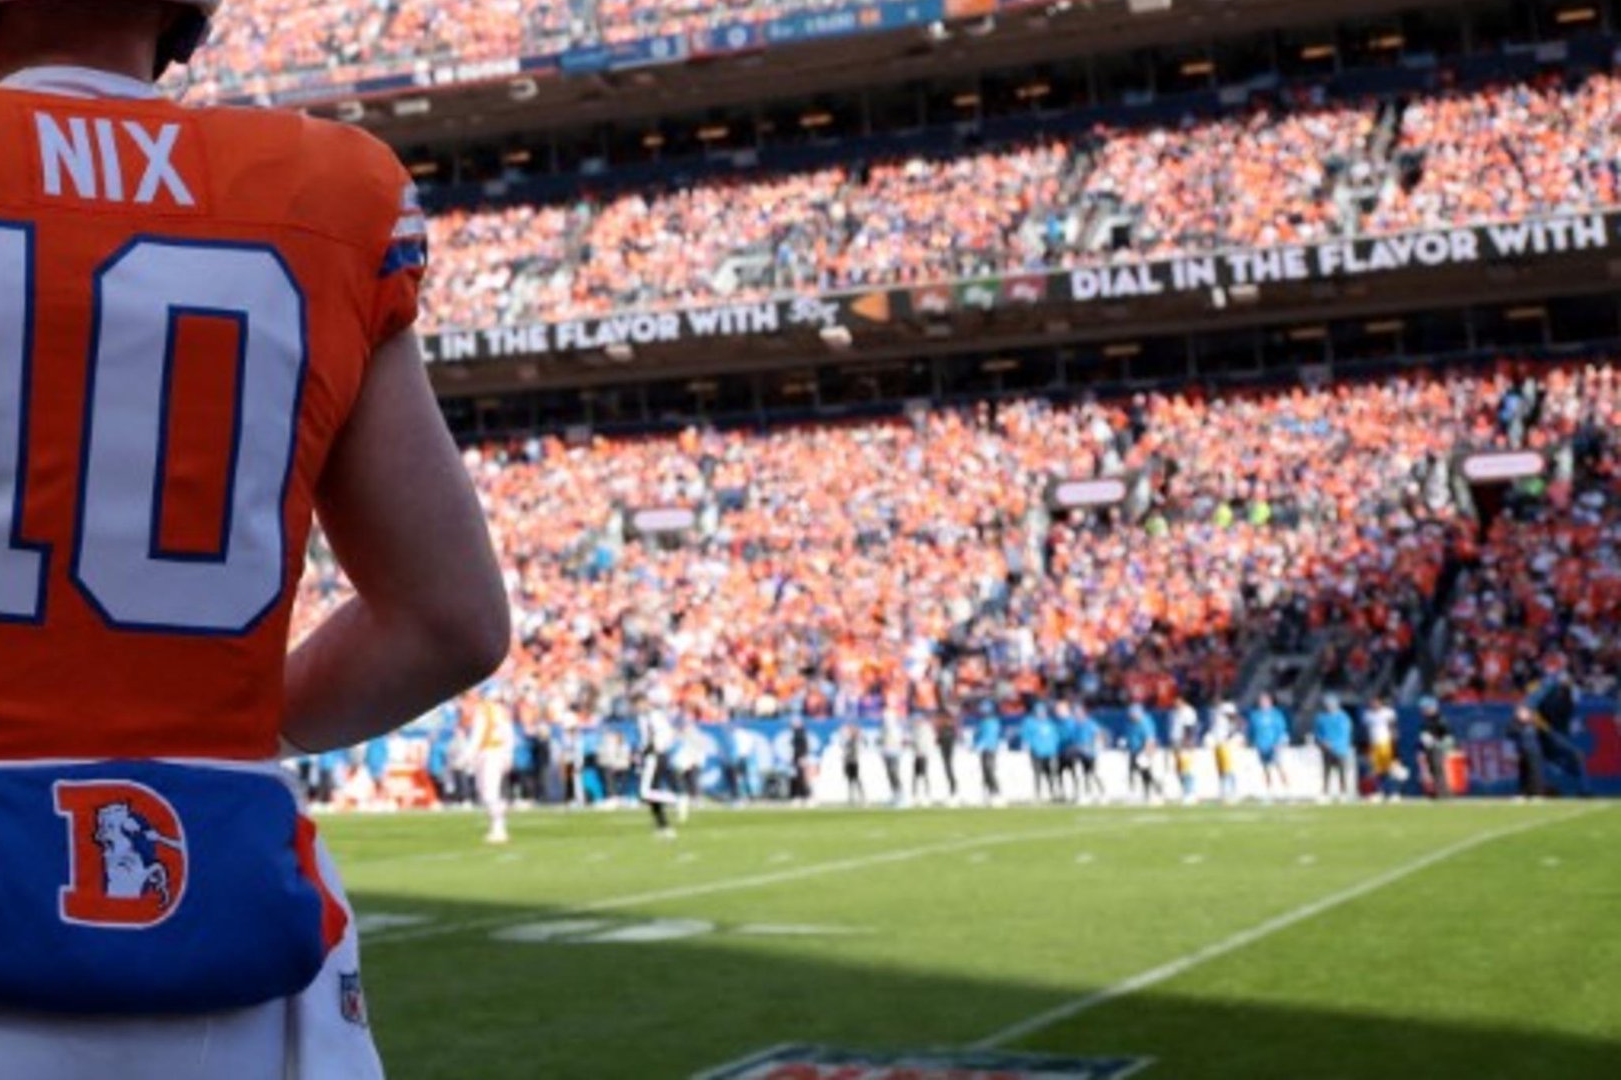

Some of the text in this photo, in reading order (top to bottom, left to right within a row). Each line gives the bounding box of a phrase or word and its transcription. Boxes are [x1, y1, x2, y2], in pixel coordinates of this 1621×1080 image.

[34, 112, 195, 206] NIX
[1071, 263, 1163, 300] DIAL
[1172, 255, 1216, 290] IN
[1230, 246, 1310, 283] THE
[1317, 229, 1479, 276] FLAVOR
[1488, 216, 1608, 255] WITH
[441, 328, 477, 361] IN
[485, 322, 548, 357] THE
[556, 312, 680, 351] FLAVOR
[687, 302, 778, 336] WITH
